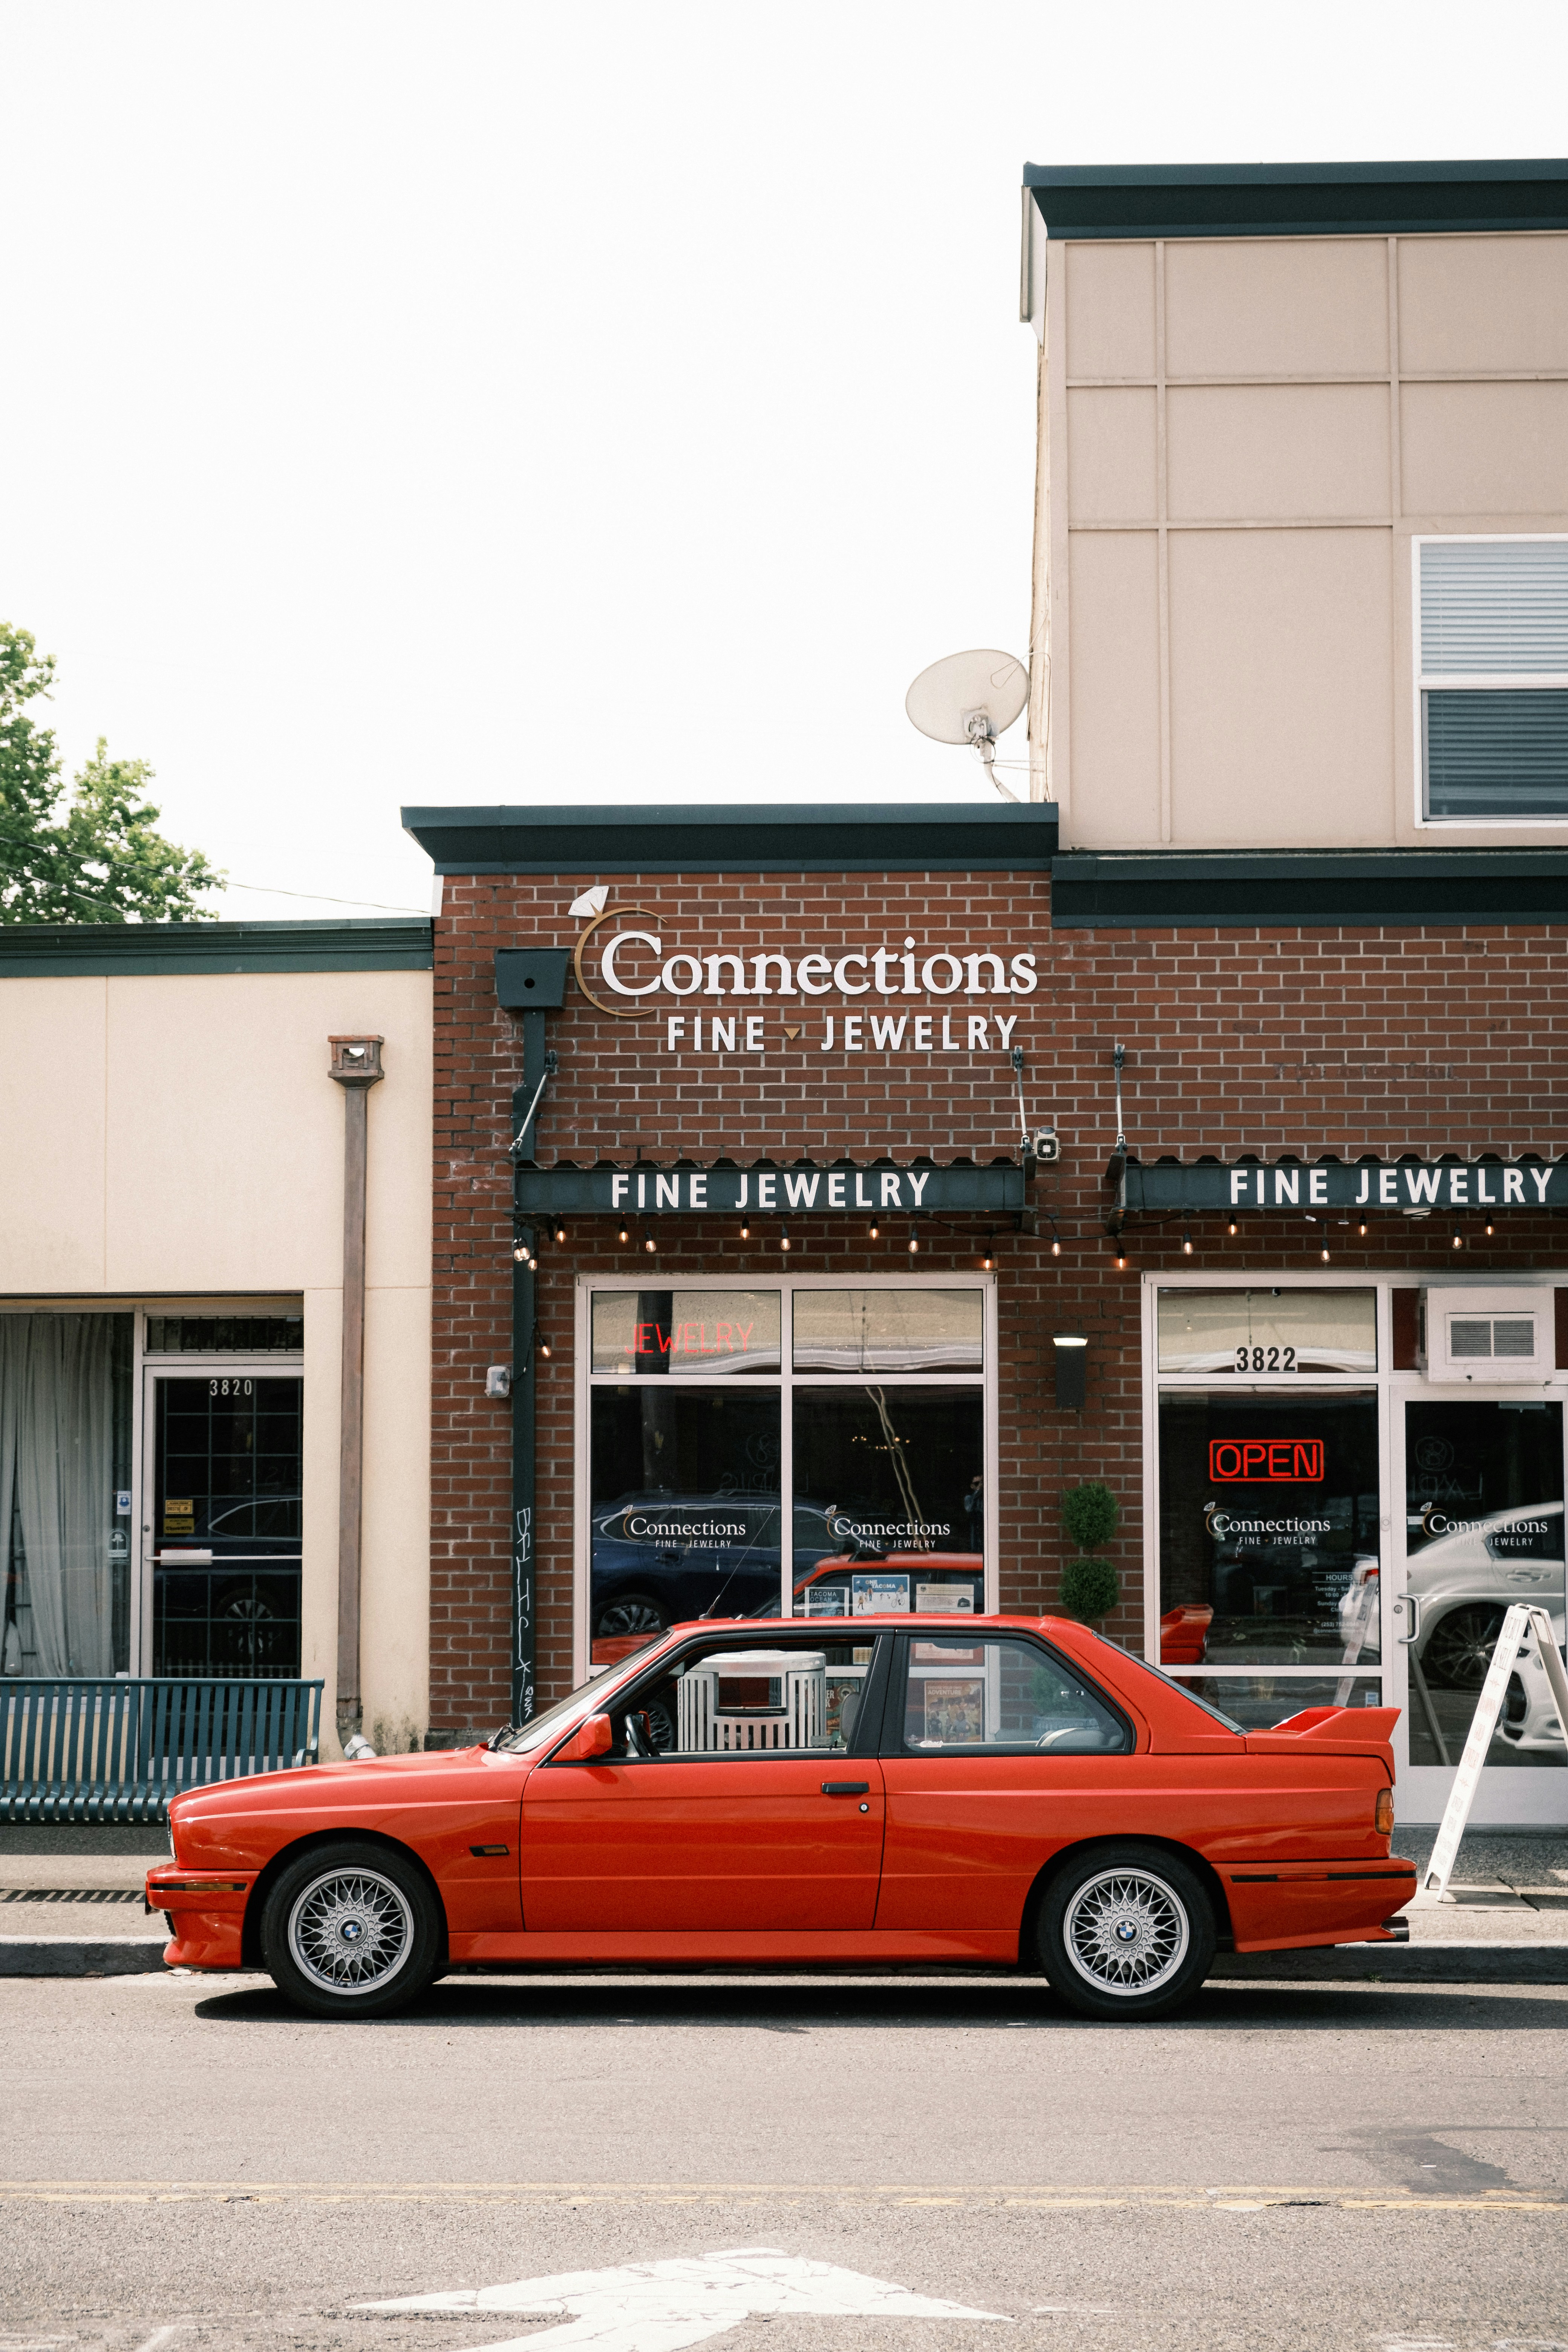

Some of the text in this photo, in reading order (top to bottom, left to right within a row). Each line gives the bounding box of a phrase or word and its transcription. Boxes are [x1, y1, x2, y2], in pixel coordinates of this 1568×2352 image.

[602, 931, 1037, 996] Connections
[668, 1015, 1018, 1051] FINE JEWELRY
[612, 1172, 930, 1208] FINE JEWELRY
[1230, 1168, 1553, 1204] FINE JEWELRY
[625, 1322, 754, 1354] JEWELRY
[1236, 1346, 1297, 1372] 3822
[210, 1380, 252, 1396] 3820
[1216, 1444, 1318, 1477] OPEN
[630, 1517, 746, 1536] Connections
[834, 1517, 950, 1536] Connections
[1213, 1514, 1330, 1533] Connections
[1430, 1515, 1548, 1533] Connections
[1239, 1536, 1316, 1545] FINE JEWELRY
